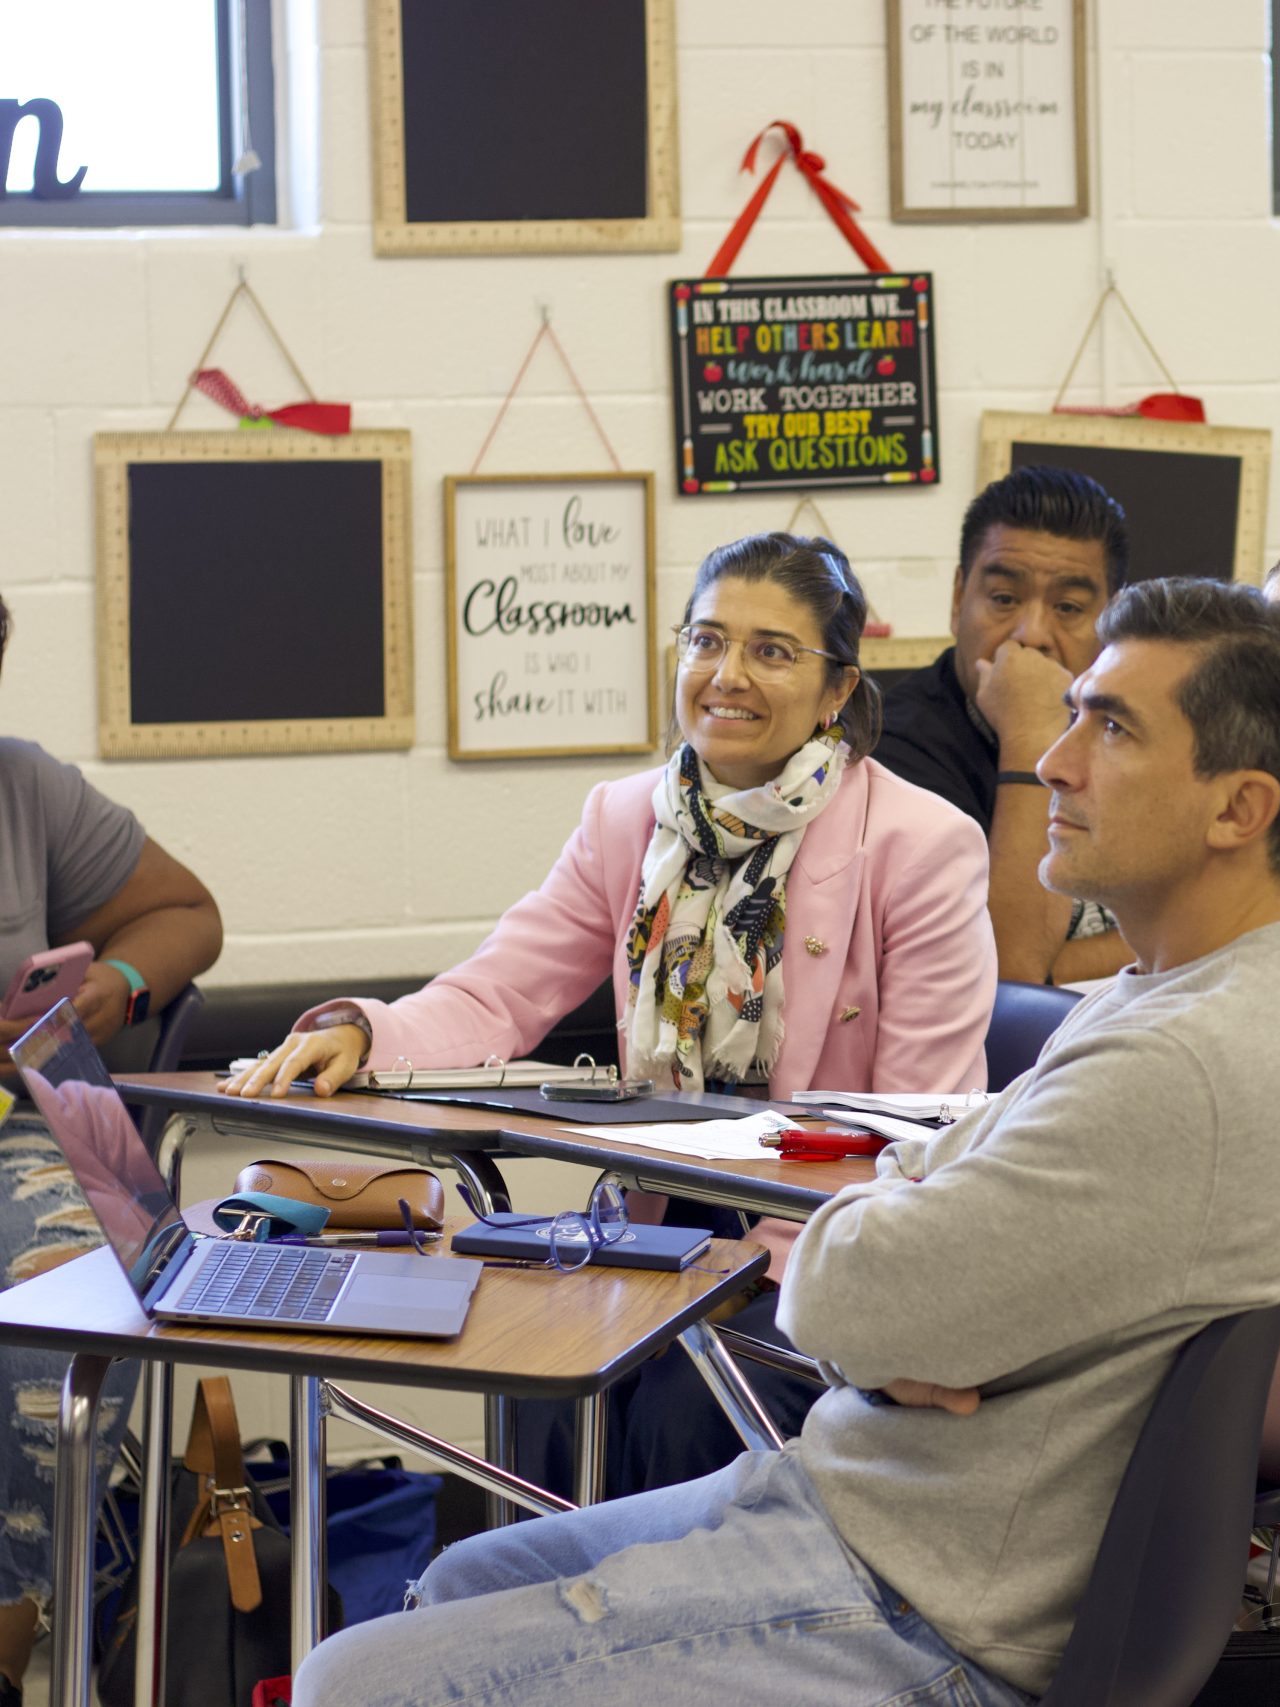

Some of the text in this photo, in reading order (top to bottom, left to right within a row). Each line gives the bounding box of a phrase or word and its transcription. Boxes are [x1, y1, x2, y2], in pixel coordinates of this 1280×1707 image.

[909, 24, 1059, 45] OF THE WORLD
[961, 60, 1005, 79] IS IN
[952, 131, 1018, 150] TODAY
[693, 299, 714, 323] IN
[717, 297, 762, 322] THIS
[763, 295, 868, 321] CLASSROOM
[695, 325, 750, 355] HELP
[755, 322, 840, 353] OTHERS
[697, 382, 918, 413] WORK TOGETHER
[743, 410, 872, 439] TRY OUR BEST
[715, 433, 908, 474] ASK QUESTIONS
[476, 518, 532, 549] WHAT
[563, 495, 621, 549] love
[520, 561, 631, 584] MOST ABOUT MY
[463, 575, 637, 637] Classroom
[524, 653, 541, 675] IS
[548, 653, 579, 675] WHO
[474, 670, 628, 722] share IT WITH
